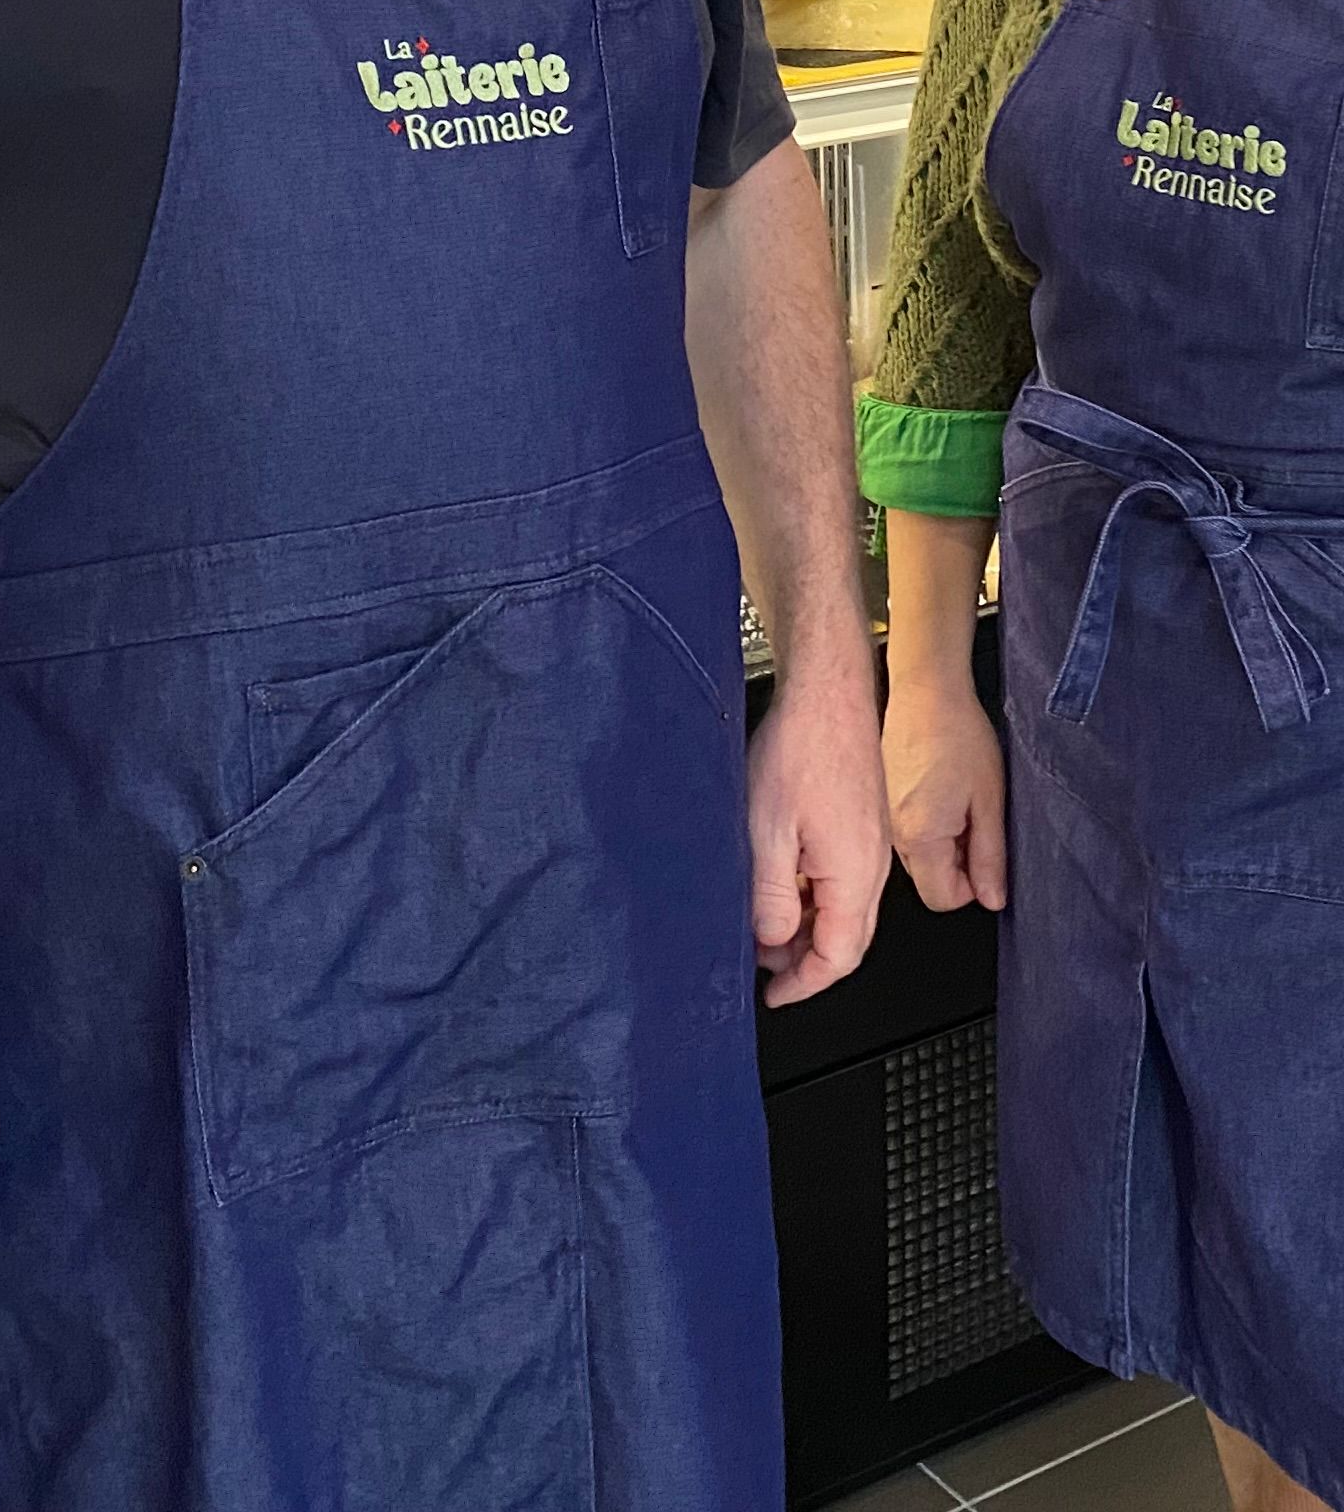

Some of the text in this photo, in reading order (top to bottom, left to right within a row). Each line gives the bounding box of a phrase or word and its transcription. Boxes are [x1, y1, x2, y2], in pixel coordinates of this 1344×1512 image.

[383, 38, 414, 60] La
[356, 42, 571, 113] Laiterie
[1152, 91, 1174, 112] La
[404, 102, 574, 151] Rennaise
[1117, 99, 1287, 178] Laiterie
[1131, 155, 1277, 215] Rennaise
